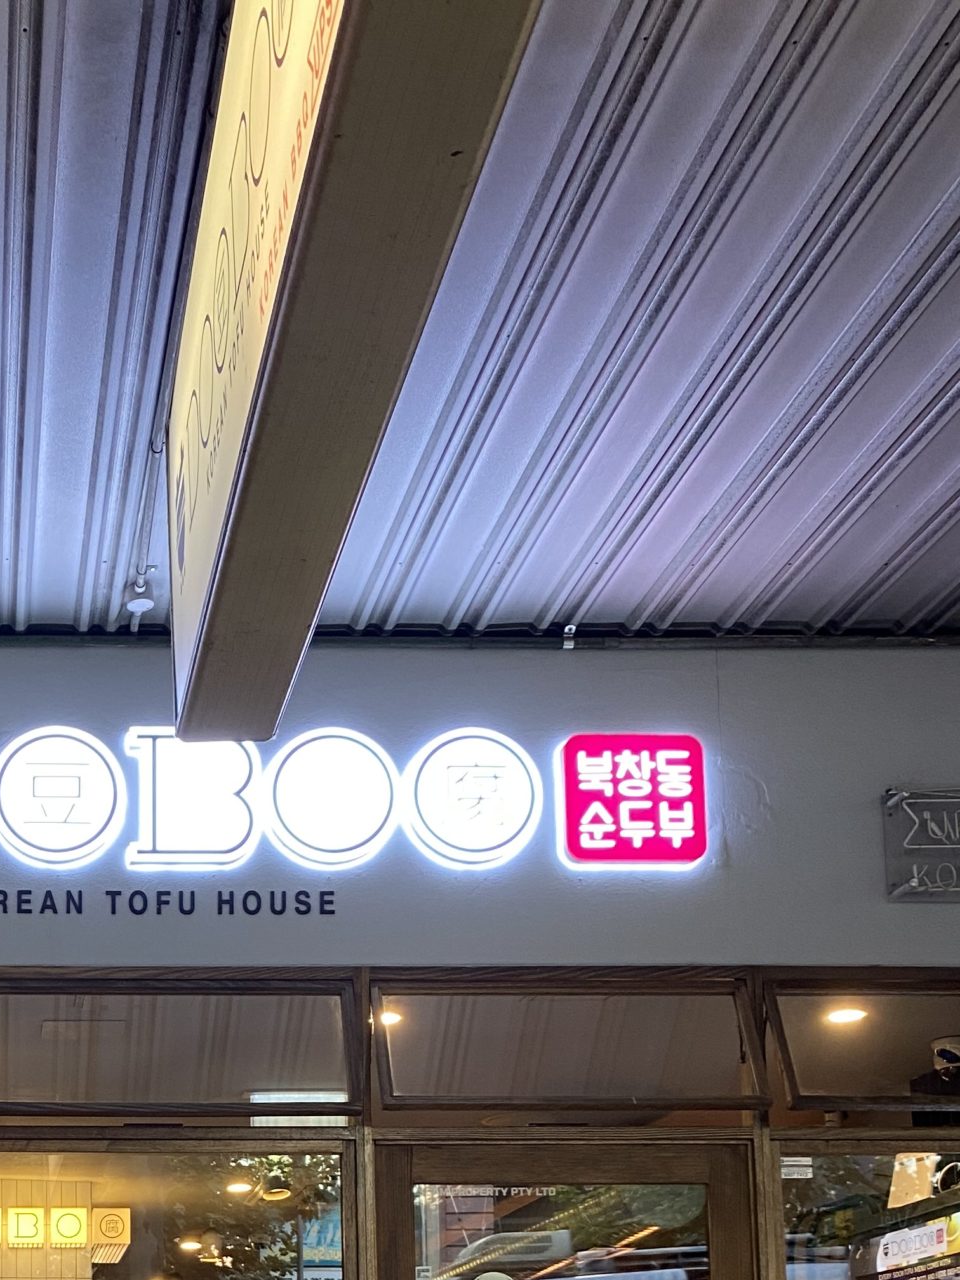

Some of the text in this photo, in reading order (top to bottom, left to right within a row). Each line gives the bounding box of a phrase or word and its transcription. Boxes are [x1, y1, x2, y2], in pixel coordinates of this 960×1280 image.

[258, 179, 290, 325] KOREAN
[290, 90, 309, 184] BBQ
[206, 178, 270, 495] KOREAN TOFU HOUSE
[576, 749, 694, 798] 북창동
[578, 800, 696, 849] 순두부
[105, 889, 197, 916] TOFU
[216, 889, 337, 916] HOUSE
[511, 1187, 533, 1196] PTY
[535, 1187, 556, 1196] LTD
